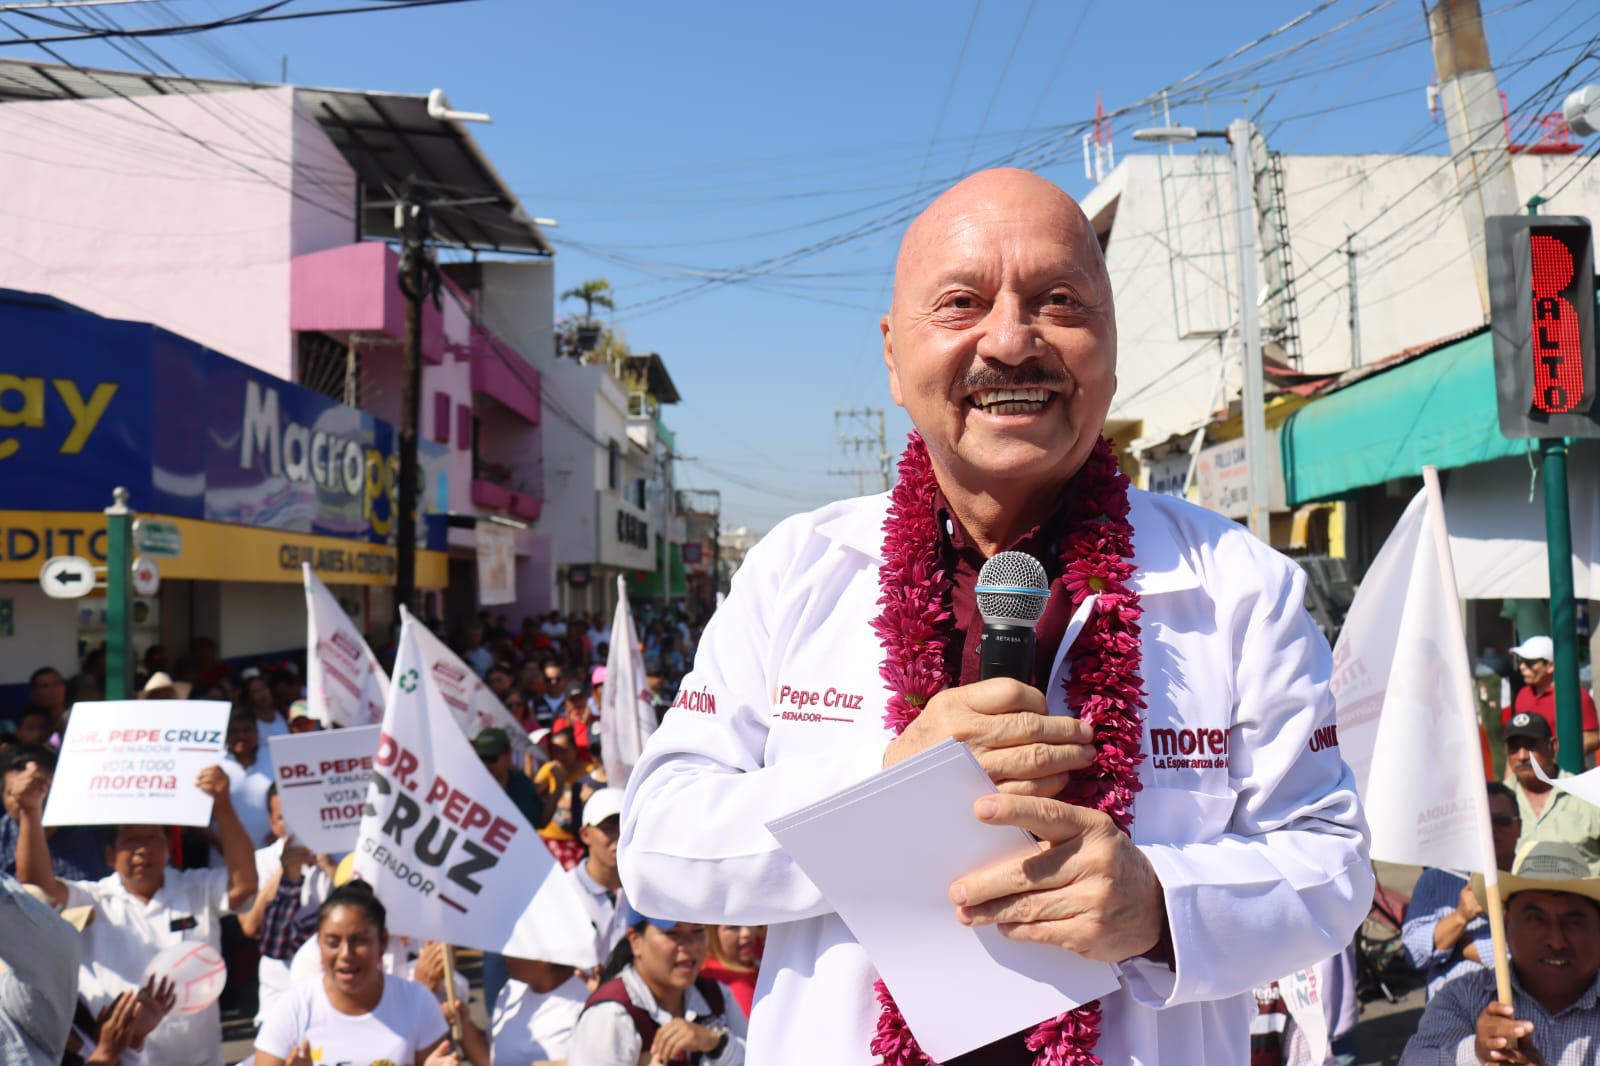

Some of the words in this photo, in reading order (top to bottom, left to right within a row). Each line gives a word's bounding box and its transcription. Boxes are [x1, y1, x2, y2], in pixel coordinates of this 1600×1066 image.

[1536, 299, 1568, 408] ALTO
[0, 527, 109, 562] DITO
[780, 685, 819, 709] Pepe
[823, 688, 864, 710] Cruz
[782, 711, 822, 722] SENADOR
[109, 728, 161, 743] PEPE
[164, 729, 221, 744] CRUZ
[103, 760, 135, 772] VOTA
[139, 760, 176, 772] TODO
[279, 764, 315, 779] DR.
[320, 756, 373, 774] PEPE
[1153, 757, 1166, 769] La
[1167, 757, 1213, 772] Esperanza
[1214, 757, 1225, 768] de
[89, 774, 177, 790] morena
[324, 789, 359, 802] VOTA
[374, 731, 419, 792] DR.
[425, 775, 518, 854] PEPE
[364, 770, 500, 896] CRUZ
